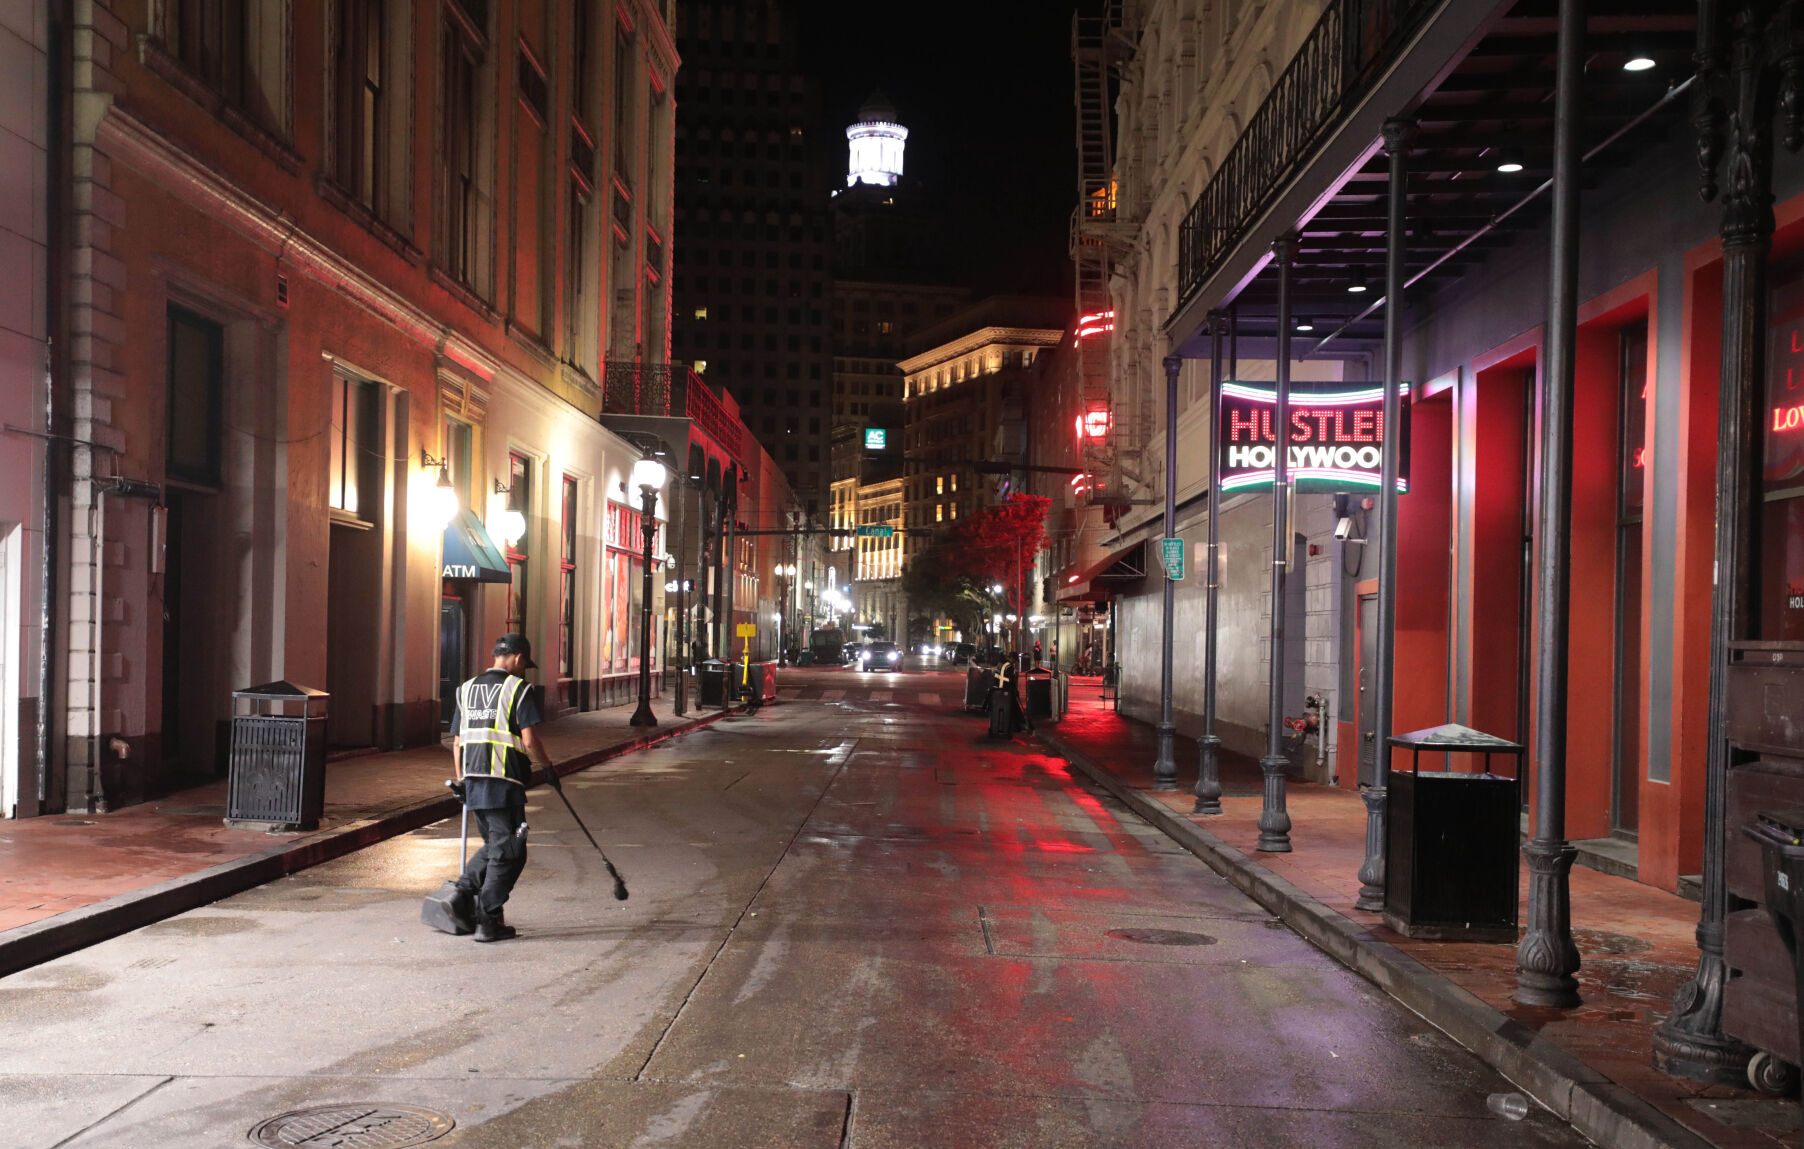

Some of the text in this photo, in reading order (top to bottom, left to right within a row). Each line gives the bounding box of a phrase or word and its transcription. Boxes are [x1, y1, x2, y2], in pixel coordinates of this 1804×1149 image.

[867, 430, 884, 440] AC
[442, 564, 476, 578] ATM
[468, 683, 503, 709] IV
